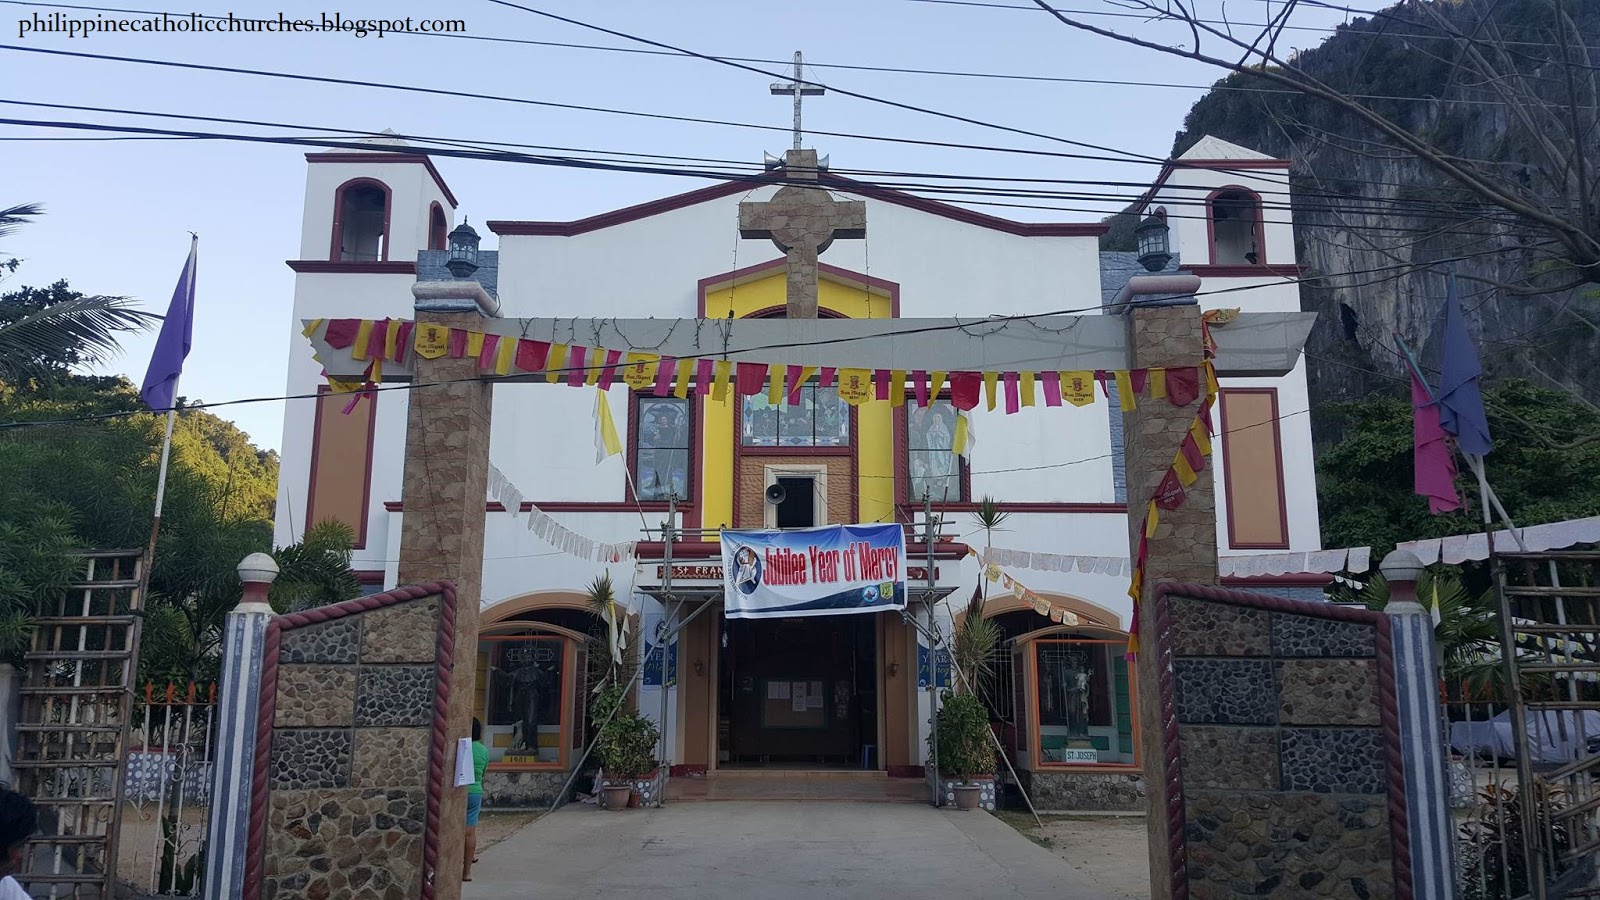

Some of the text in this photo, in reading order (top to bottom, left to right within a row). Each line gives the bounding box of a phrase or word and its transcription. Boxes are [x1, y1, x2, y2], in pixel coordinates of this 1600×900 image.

[762, 541, 899, 587] Jubilee Year of Mercy
